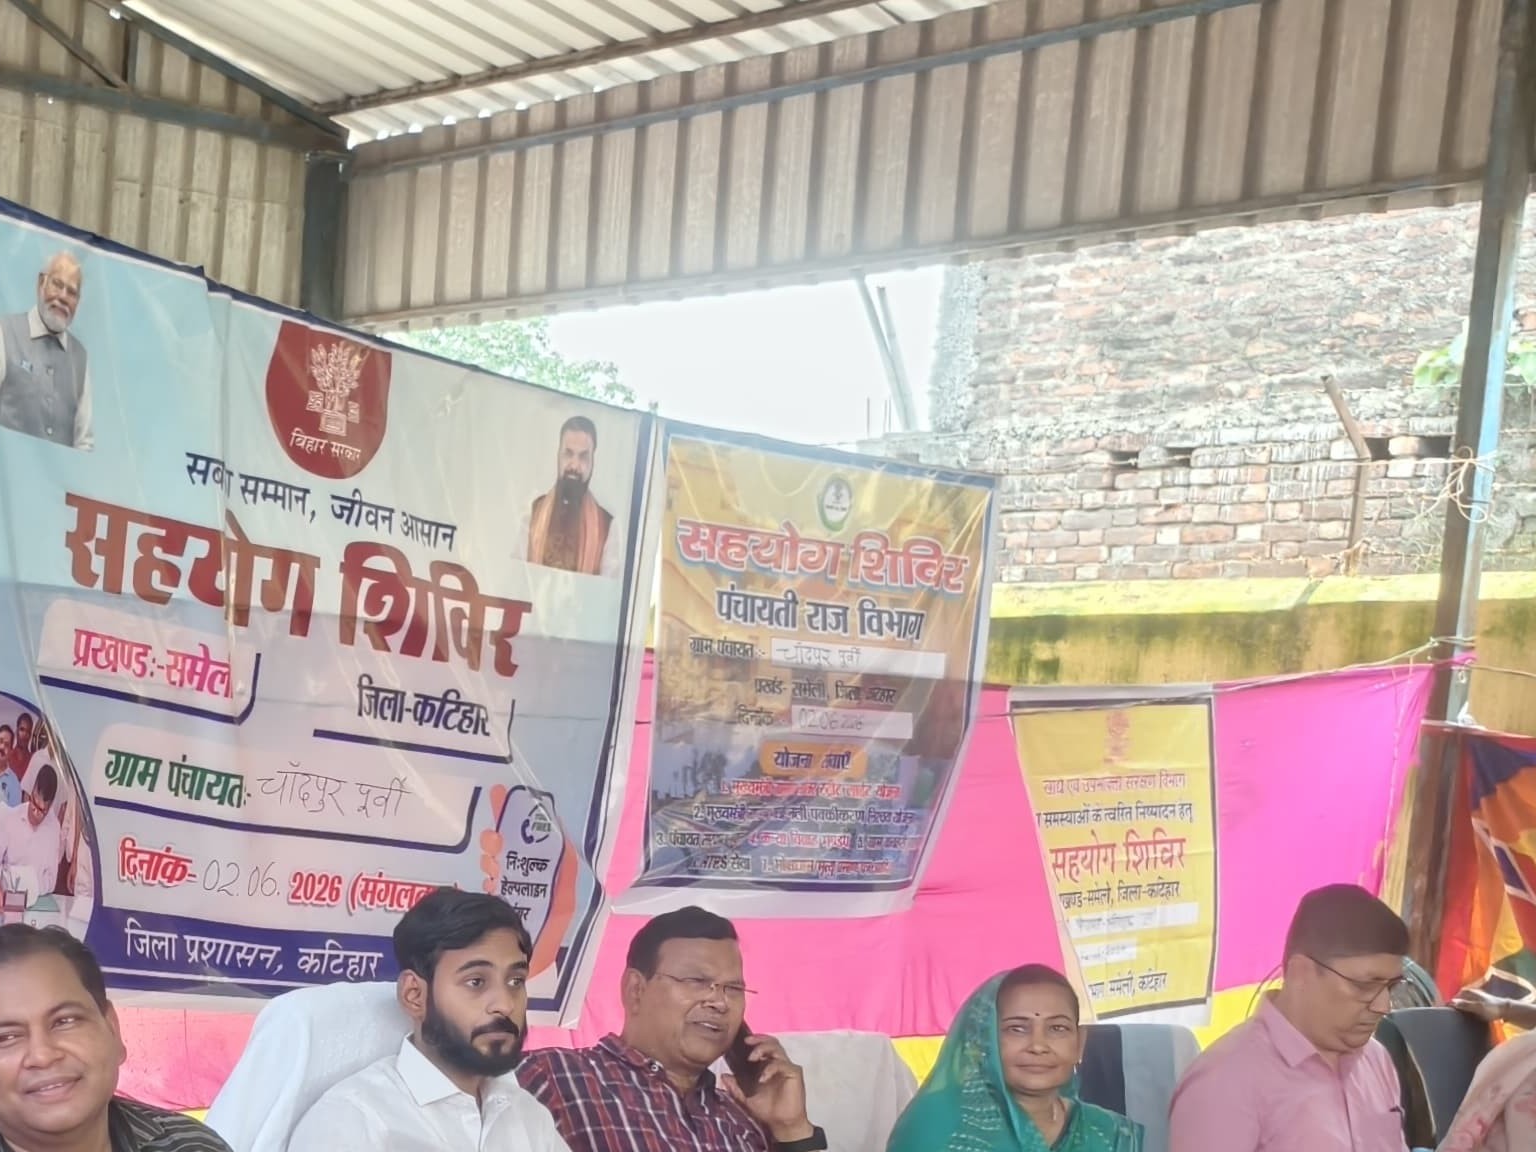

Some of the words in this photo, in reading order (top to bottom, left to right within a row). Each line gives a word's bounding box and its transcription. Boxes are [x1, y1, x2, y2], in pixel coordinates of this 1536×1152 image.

[239, 472, 315, 523] सम्मान,
[330, 488, 395, 533] जीवन
[400, 511, 457, 551] आसान
[65, 493, 320, 638] सहयोग
[339, 540, 533, 678] शिविर
[677, 519, 845, 579] सहयोग
[848, 530, 969, 593] शिविर
[717, 583, 799, 629] पंचायती
[805, 600, 849, 635] राज
[858, 598, 926, 640] विभाग
[104, 748, 163, 792] ग्राम
[1048, 829, 1117, 884] सहयोग
[1122, 826, 1187, 876] शिविर
[291, 872, 343, 904] 2026
[124, 917, 178, 962] जिला
[183, 933, 284, 976] प्रशासन,
[297, 938, 384, 978] कटिहार
